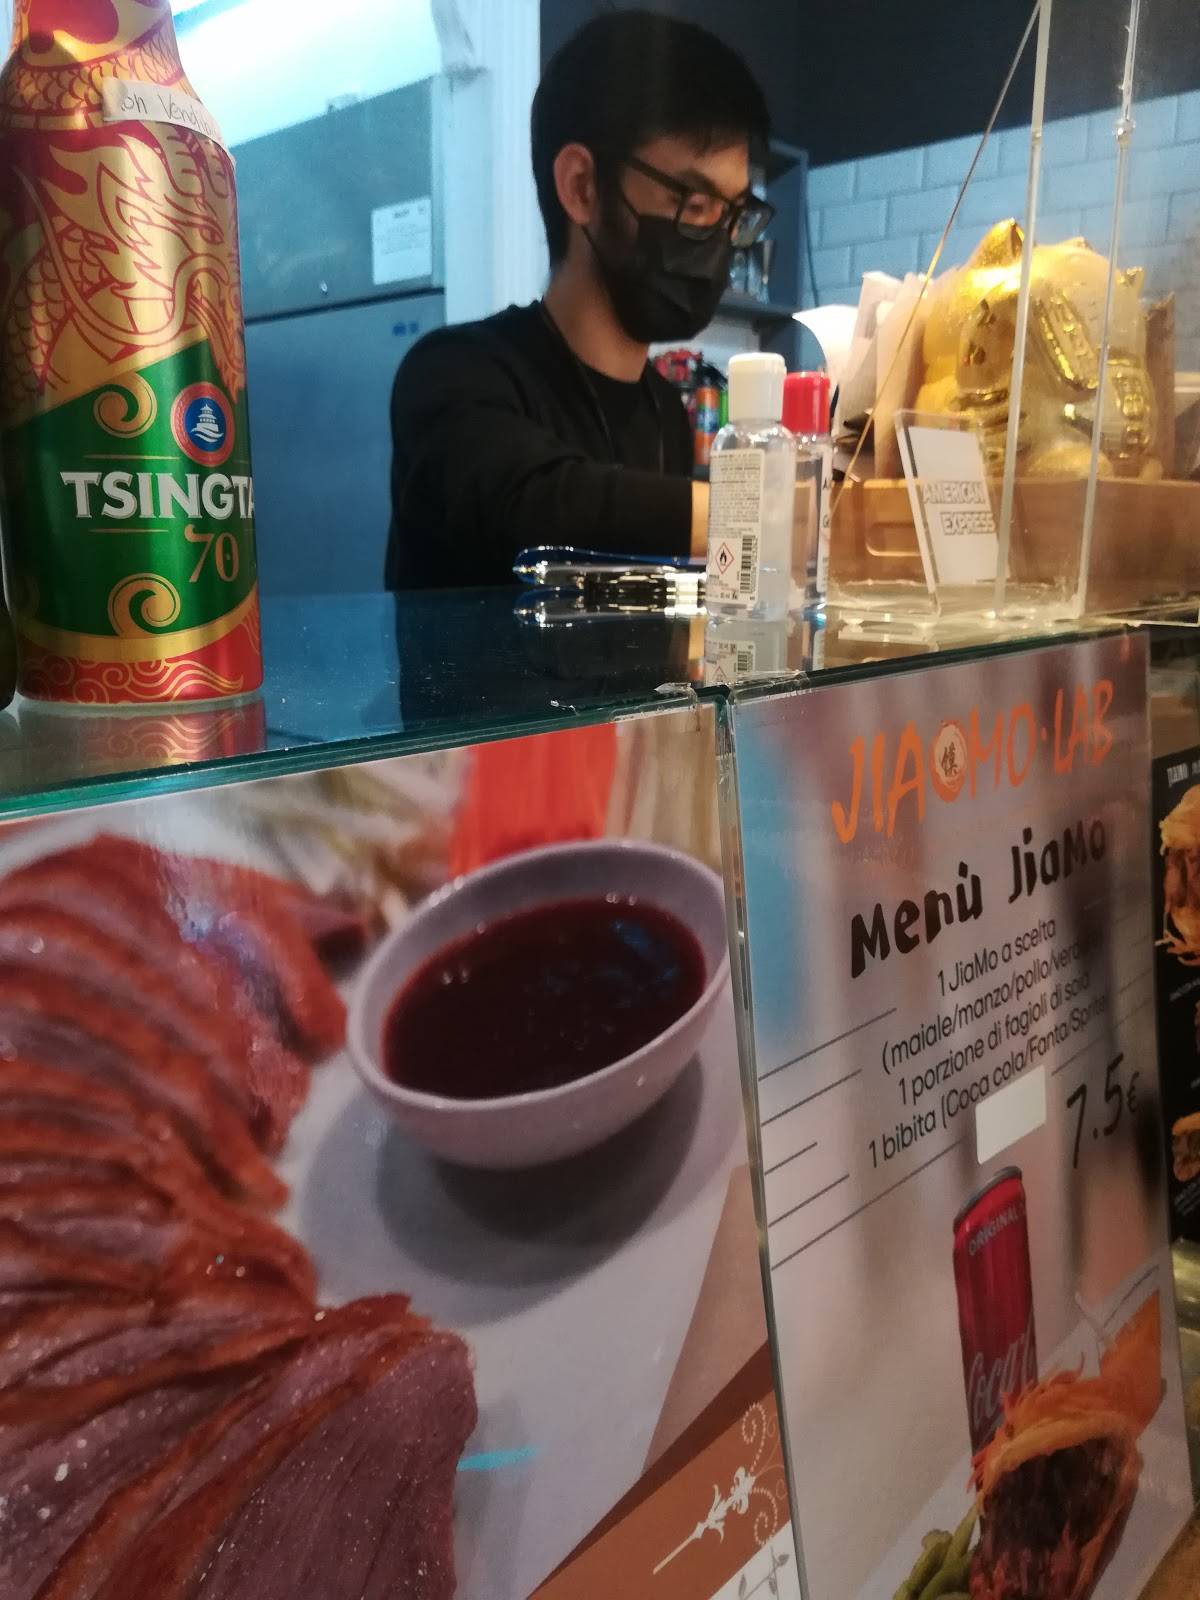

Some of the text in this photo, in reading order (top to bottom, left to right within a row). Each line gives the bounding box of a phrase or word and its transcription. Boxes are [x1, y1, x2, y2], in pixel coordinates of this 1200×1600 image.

[922, 480, 986, 505] AMERICAN
[940, 510, 996, 536] EXPRESS
[184, 524, 239, 583] 70
[851, 819, 1106, 979] Menù JiaMo
[937, 919, 1056, 997] 1 JiaMo a scelta
[898, 1076, 908, 1106] 1
[910, 1037, 985, 1106] porzione
[987, 1022, 1003, 1051] di
[1005, 992, 1048, 1040] fagioli
[1050, 983, 1063, 1011] di
[868, 1140, 879, 1169] 1
[881, 1109, 938, 1163] bibita
